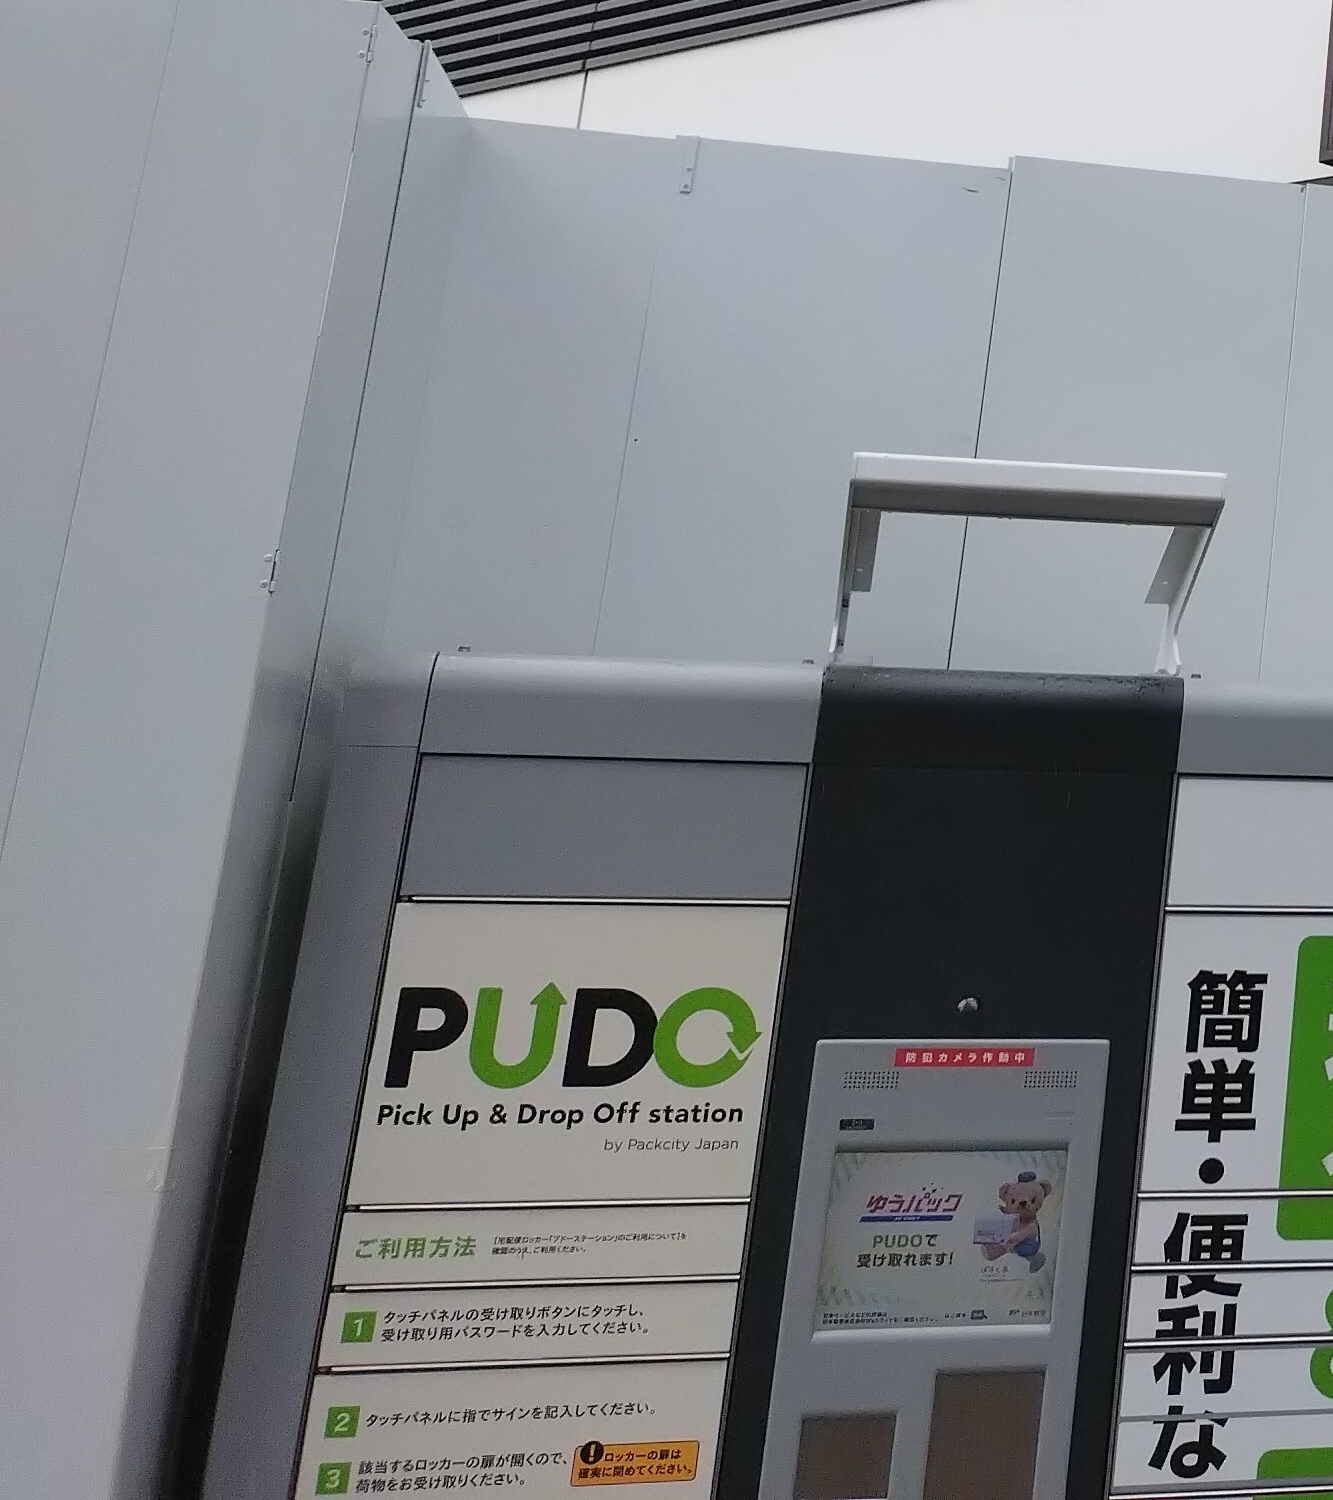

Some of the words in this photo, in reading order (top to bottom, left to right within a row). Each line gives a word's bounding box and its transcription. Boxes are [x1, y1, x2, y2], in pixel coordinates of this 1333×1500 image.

[383, 981, 763, 1090] PUDO
[905, 1050, 1026, 1064] 防犯カメラ作動中
[376, 1102, 432, 1127] Pick
[442, 1103, 480, 1131] Up
[488, 1104, 508, 1125] &
[516, 1102, 585, 1130] Drop
[593, 1100, 643, 1124] Off
[648, 1102, 744, 1124] station
[603, 1137, 623, 1152] by
[627, 1137, 691, 1152] Packcity
[694, 1137, 740, 1152] Japan
[866, 1191, 963, 1214] ゆうパック
[1147, 969, 1268, 1479] 簡単・便利な
[354, 1235, 478, 1260] ご利用方法
[872, 1233, 939, 1249] PUDOで
[383, 1303, 645, 1324] タッチパネルの受け取りボタンにタッチし、
[381, 1321, 649, 1343] 受け取り用パスワードを入力してください。
[333, 1411, 351, 1432] 2
[365, 1401, 657, 1428] タッチパネルに指でサインを記入してください。
[358, 1451, 568, 1476] 該当するロッカーの扉が開くので、
[604, 1448, 682, 1462] ロッカーの扉は
[325, 1468, 341, 1489] 3
[355, 1471, 526, 1494] 荷物をお受け取りください。
